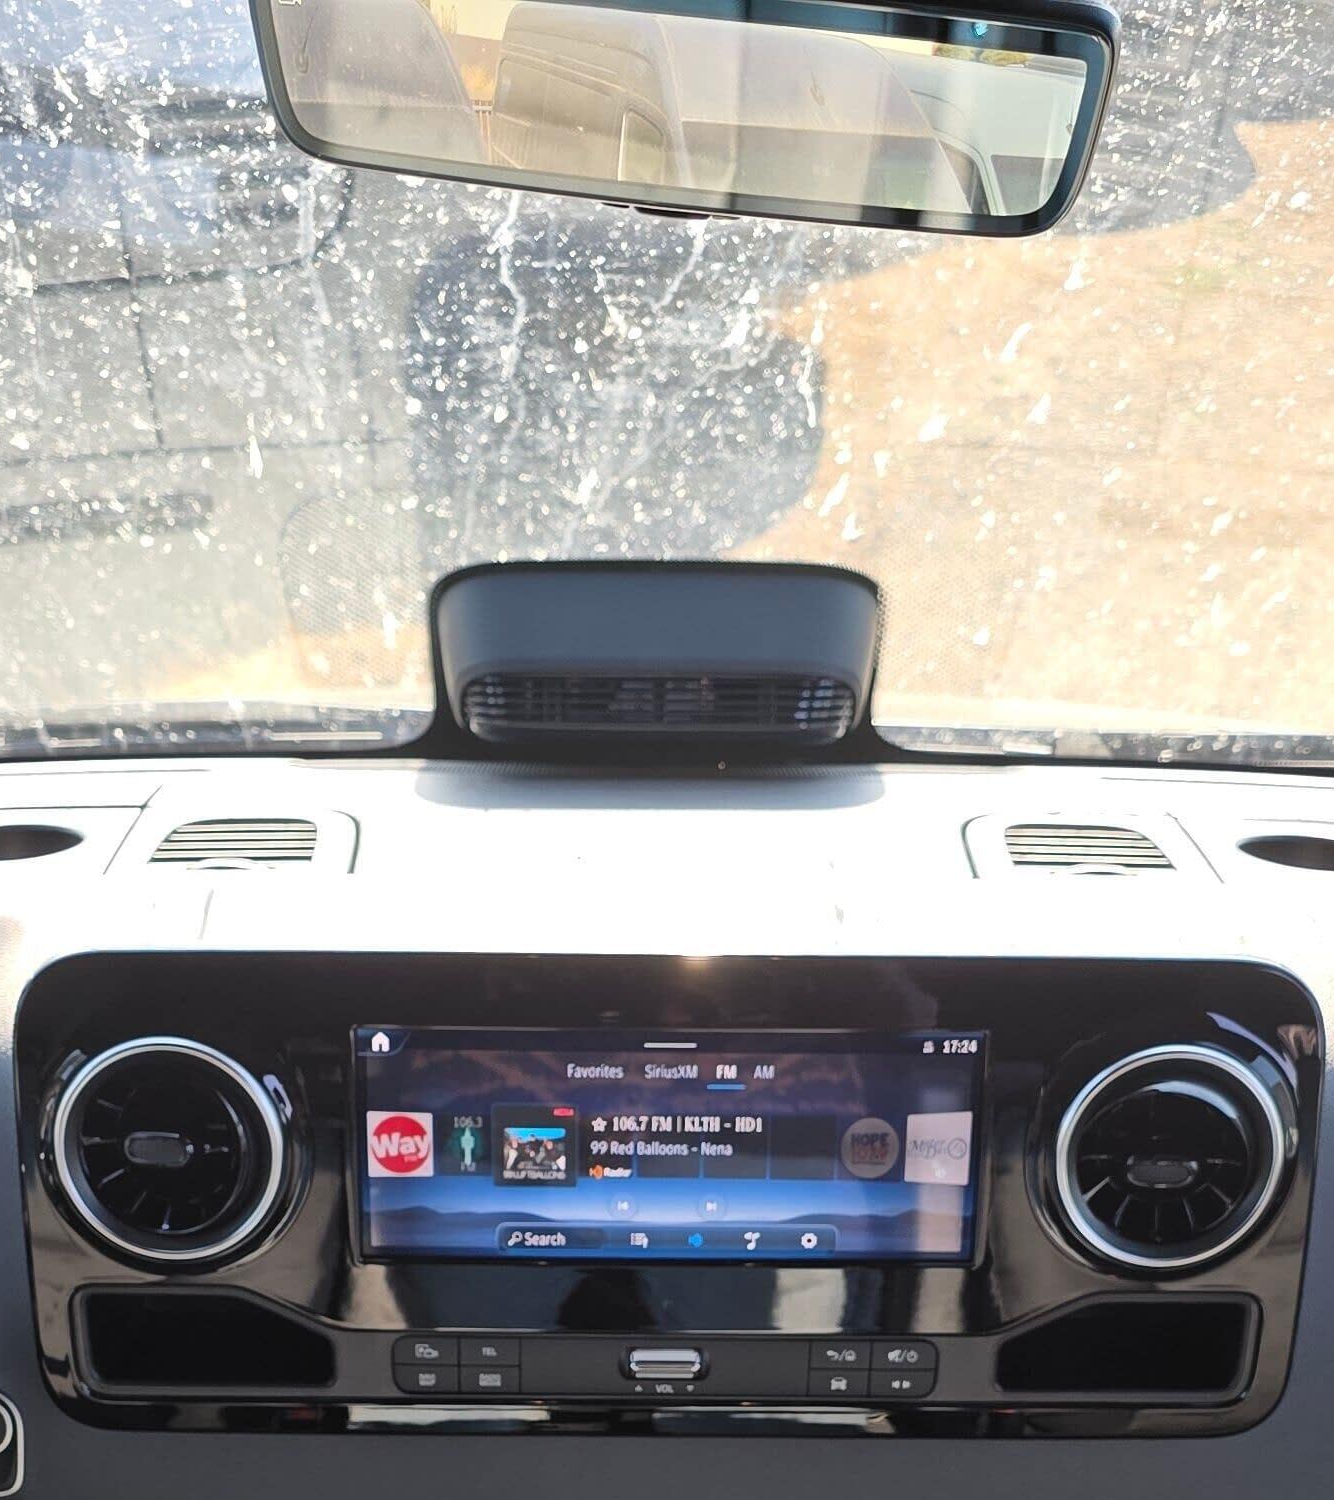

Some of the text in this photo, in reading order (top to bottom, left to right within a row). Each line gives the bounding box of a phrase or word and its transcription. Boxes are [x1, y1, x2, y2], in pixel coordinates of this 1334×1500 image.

[942, 1039, 978, 1054] 17:24
[567, 1063, 624, 1079] Favorites
[644, 1064, 698, 1079] SiriusXM
[716, 1064, 738, 1079] FM
[753, 1064, 775, 1079] AM
[612, 1116, 649, 1132] 106.7
[651, 1116, 672, 1132] FM
[735, 1116, 763, 1133] HD1
[371, 1131, 430, 1160] Way
[850, 1132, 890, 1147] HOPE
[590, 1140, 608, 1155] 99
[610, 1140, 635, 1156] Red
[636, 1141, 689, 1156] Balloons
[701, 1141, 733, 1157] Nena
[524, 1231, 566, 1246] Search
[654, 1383, 674, 1394] VOL
